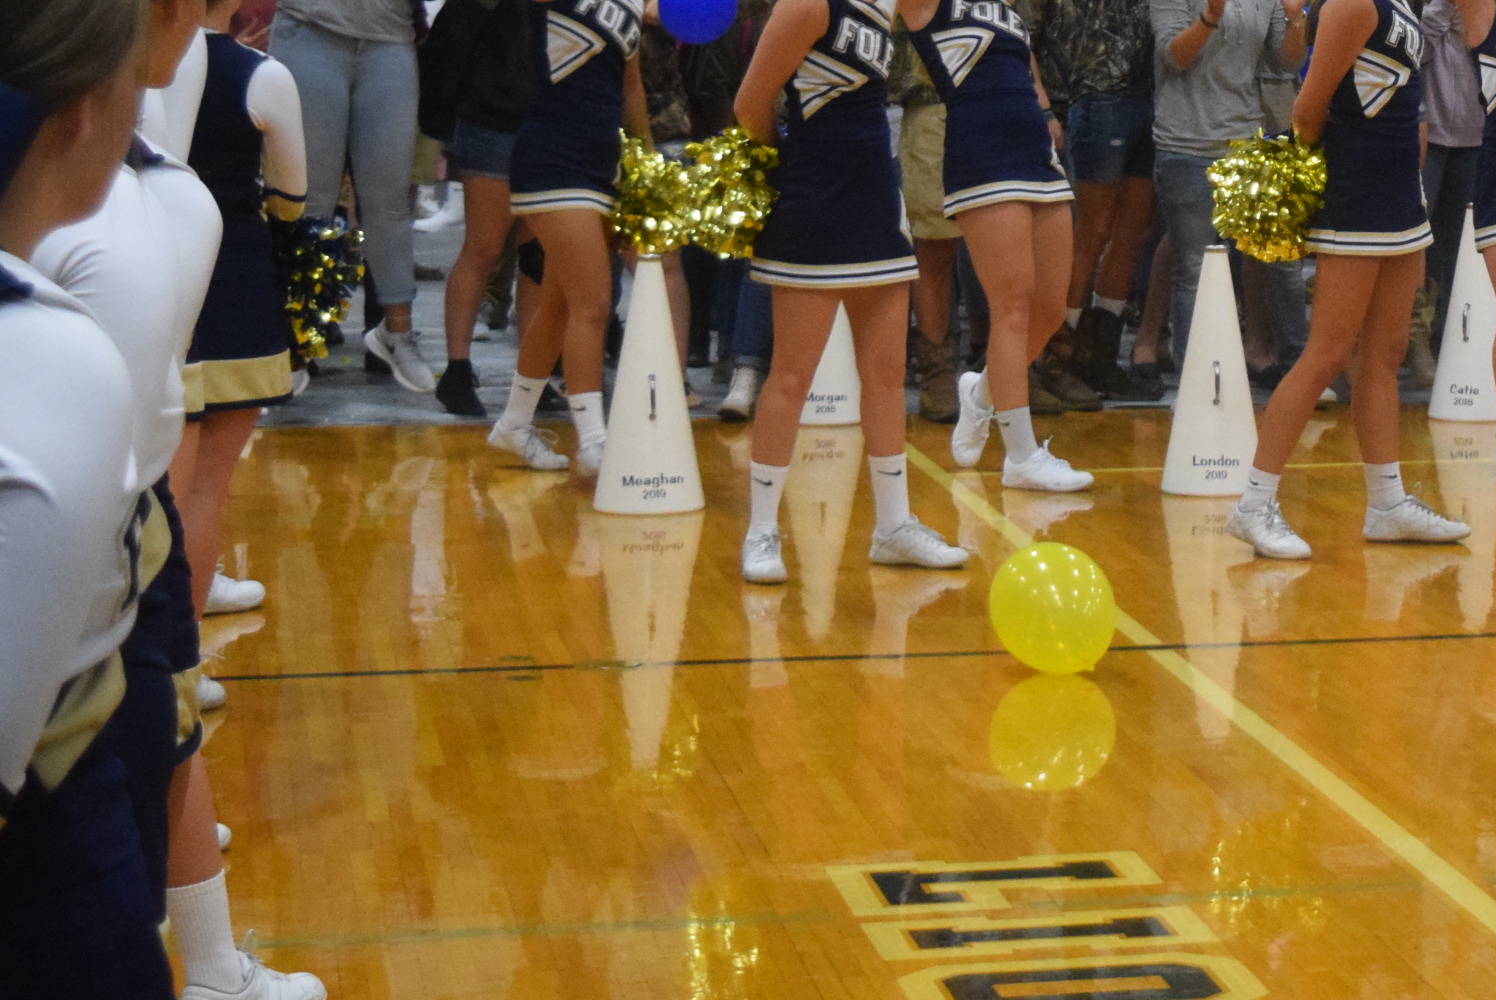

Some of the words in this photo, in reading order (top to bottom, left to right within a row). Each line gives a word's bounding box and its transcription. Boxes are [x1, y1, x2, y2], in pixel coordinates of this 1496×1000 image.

[806, 391, 847, 404] Morgan
[1192, 455, 1240, 466] London
[622, 472, 684, 488] Meaghan
[1205, 470, 1228, 480] 2019
[643, 489, 667, 500] 2019
